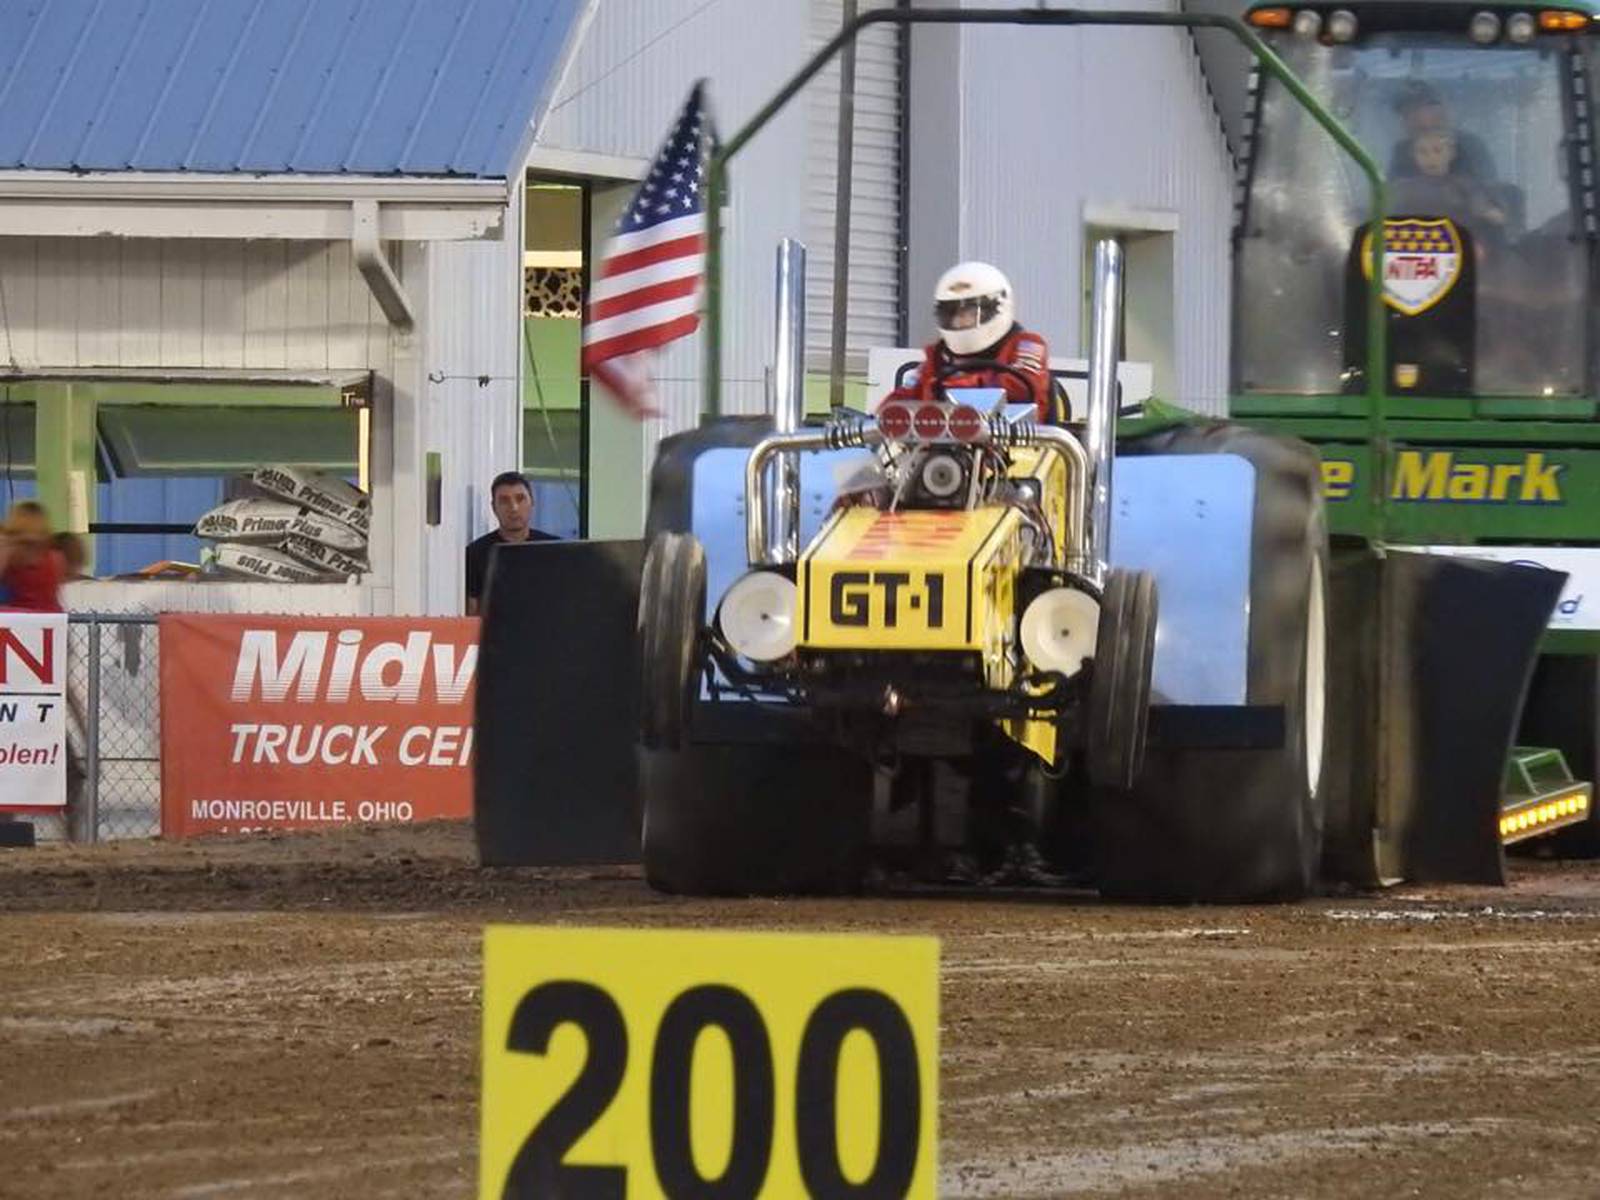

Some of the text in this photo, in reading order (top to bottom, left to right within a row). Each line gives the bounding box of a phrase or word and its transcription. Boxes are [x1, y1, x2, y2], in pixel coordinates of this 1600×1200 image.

[1388, 450, 1565, 503] Mark
[298, 486, 347, 514] Primer
[241, 517, 288, 532] Primer
[291, 516, 323, 537] Plus
[230, 725, 388, 766] TRUCK
[191, 799, 414, 822] MONROEVILLE, OHIO
[502, 979, 922, 1200] 200
